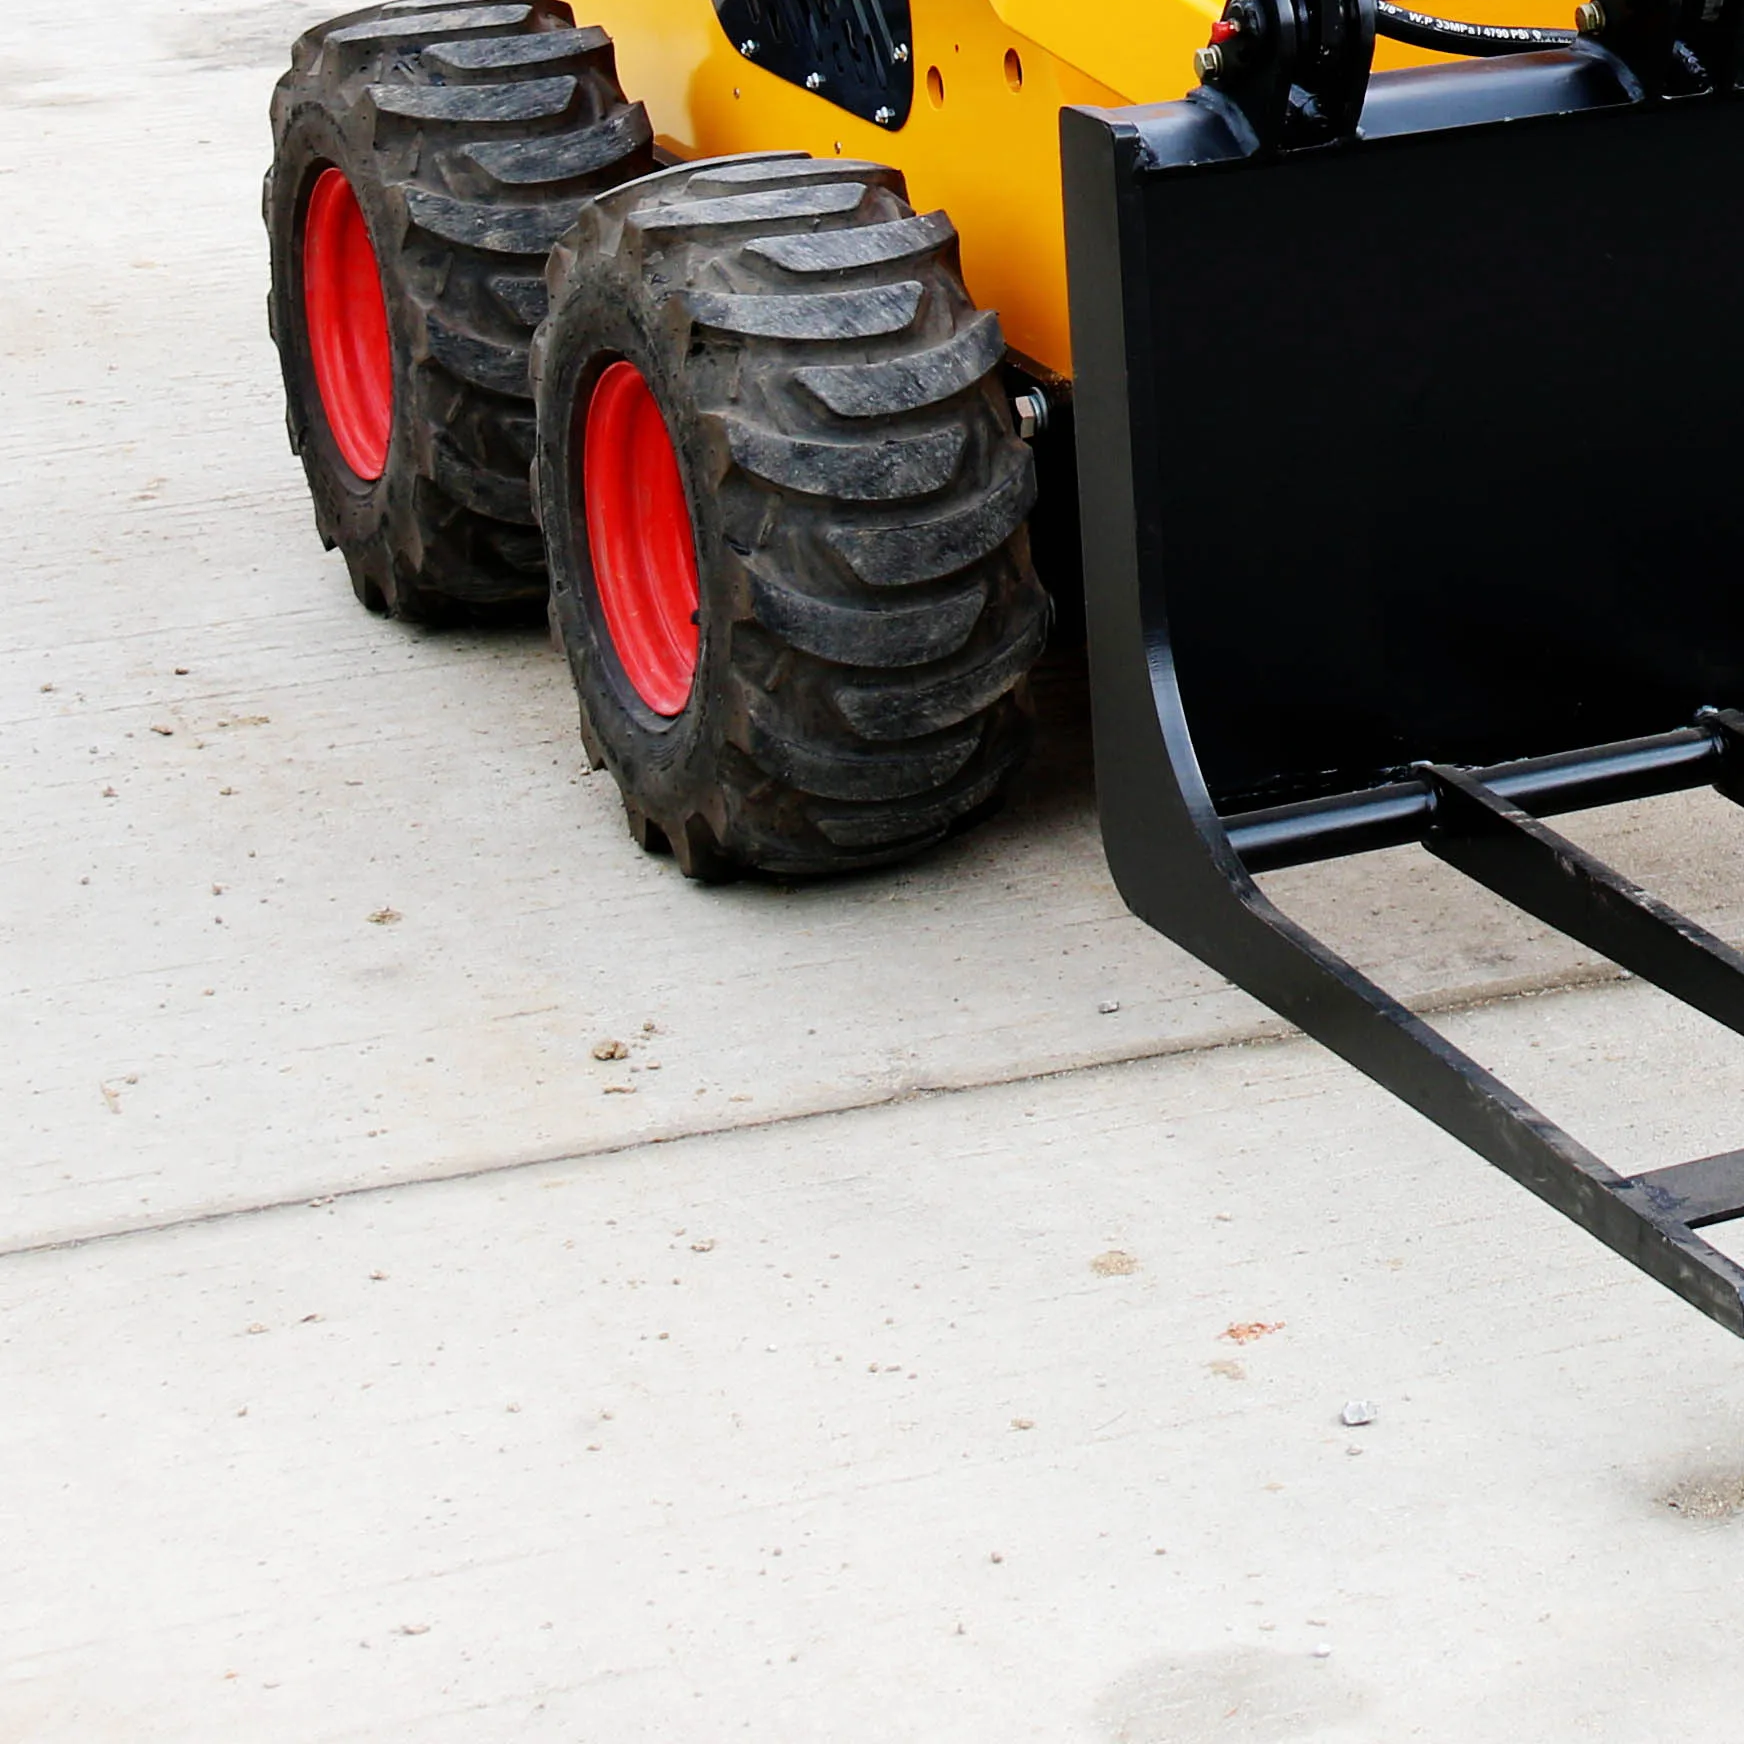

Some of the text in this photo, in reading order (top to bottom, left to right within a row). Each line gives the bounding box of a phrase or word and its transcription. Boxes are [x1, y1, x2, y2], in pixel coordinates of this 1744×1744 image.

[1409, 12, 1434, 26] W.P
[1436, 18, 1476, 35] 33MPa
[1511, 29, 1529, 40] PSI
